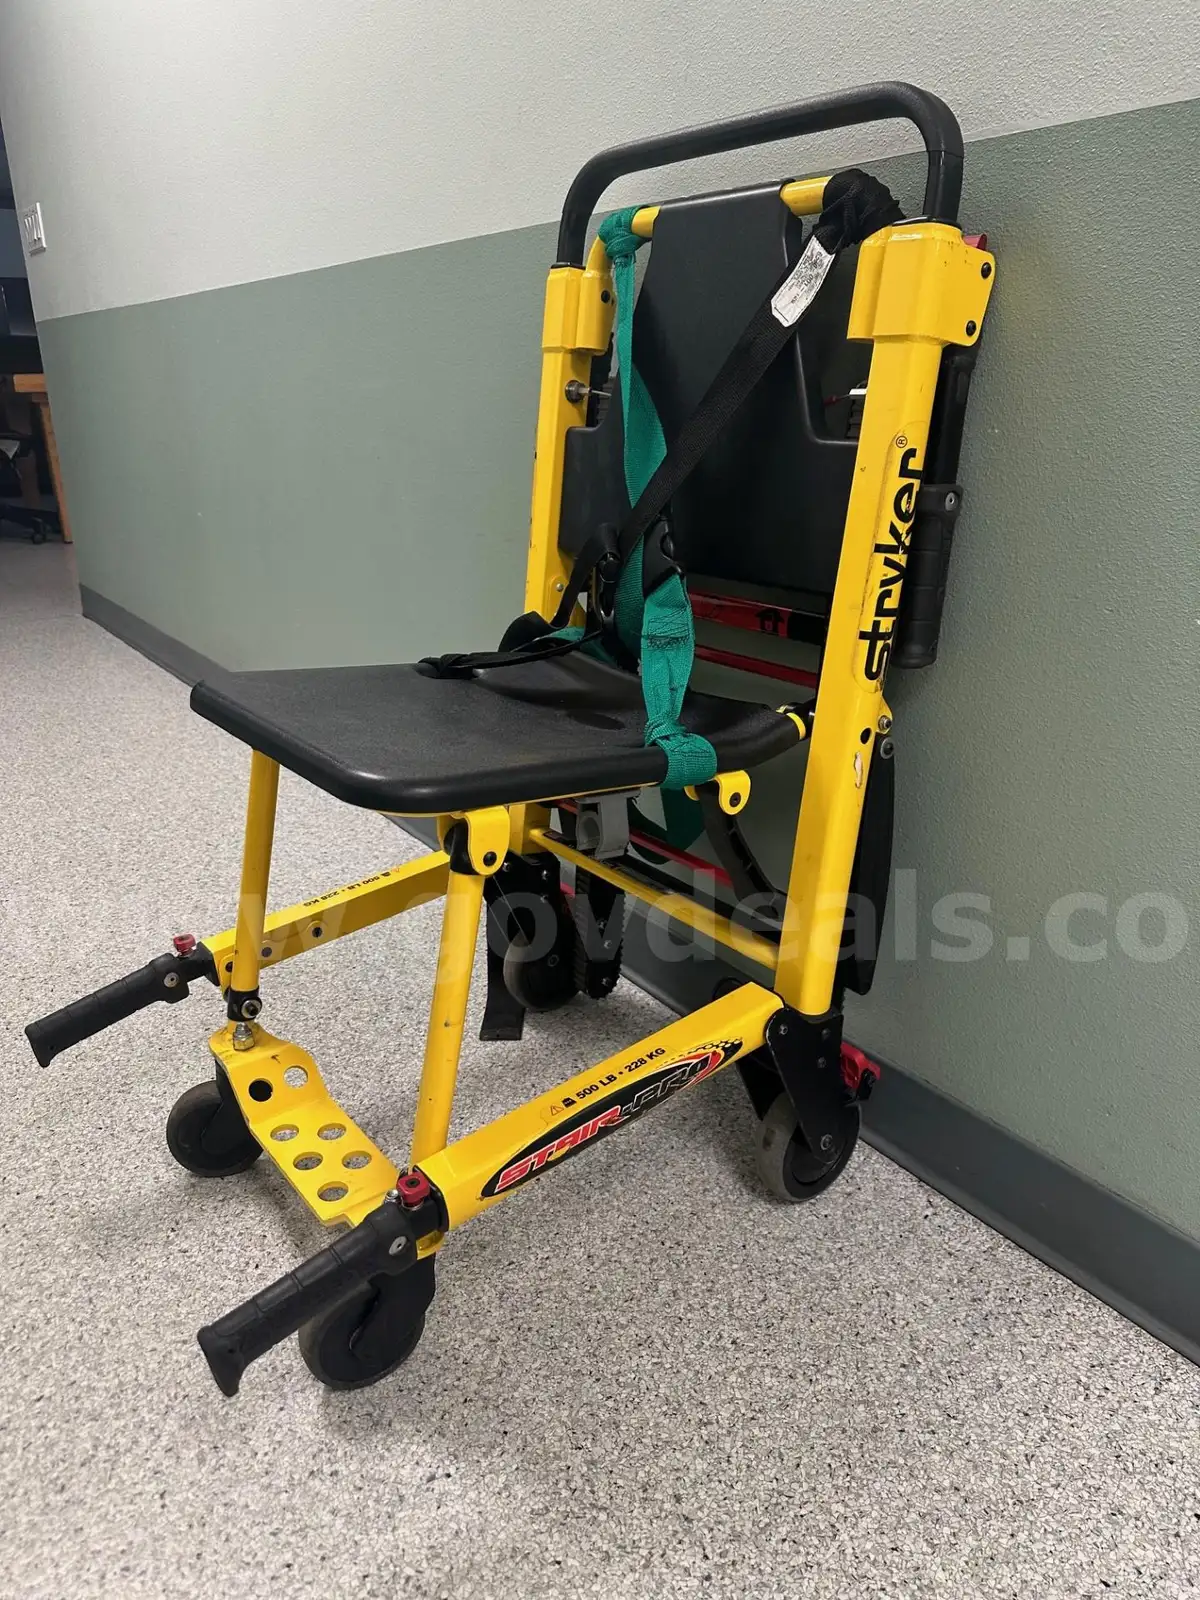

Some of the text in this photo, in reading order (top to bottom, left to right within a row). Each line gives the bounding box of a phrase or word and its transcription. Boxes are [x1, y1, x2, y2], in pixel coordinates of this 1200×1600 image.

[858, 447, 924, 681] stryker
[320, 891, 340, 900] 228
[362, 876, 380, 885] 500
[576, 1047, 666, 1100] 500 LB 228 KG
[494, 1051, 713, 1195] STAIR-PRO
